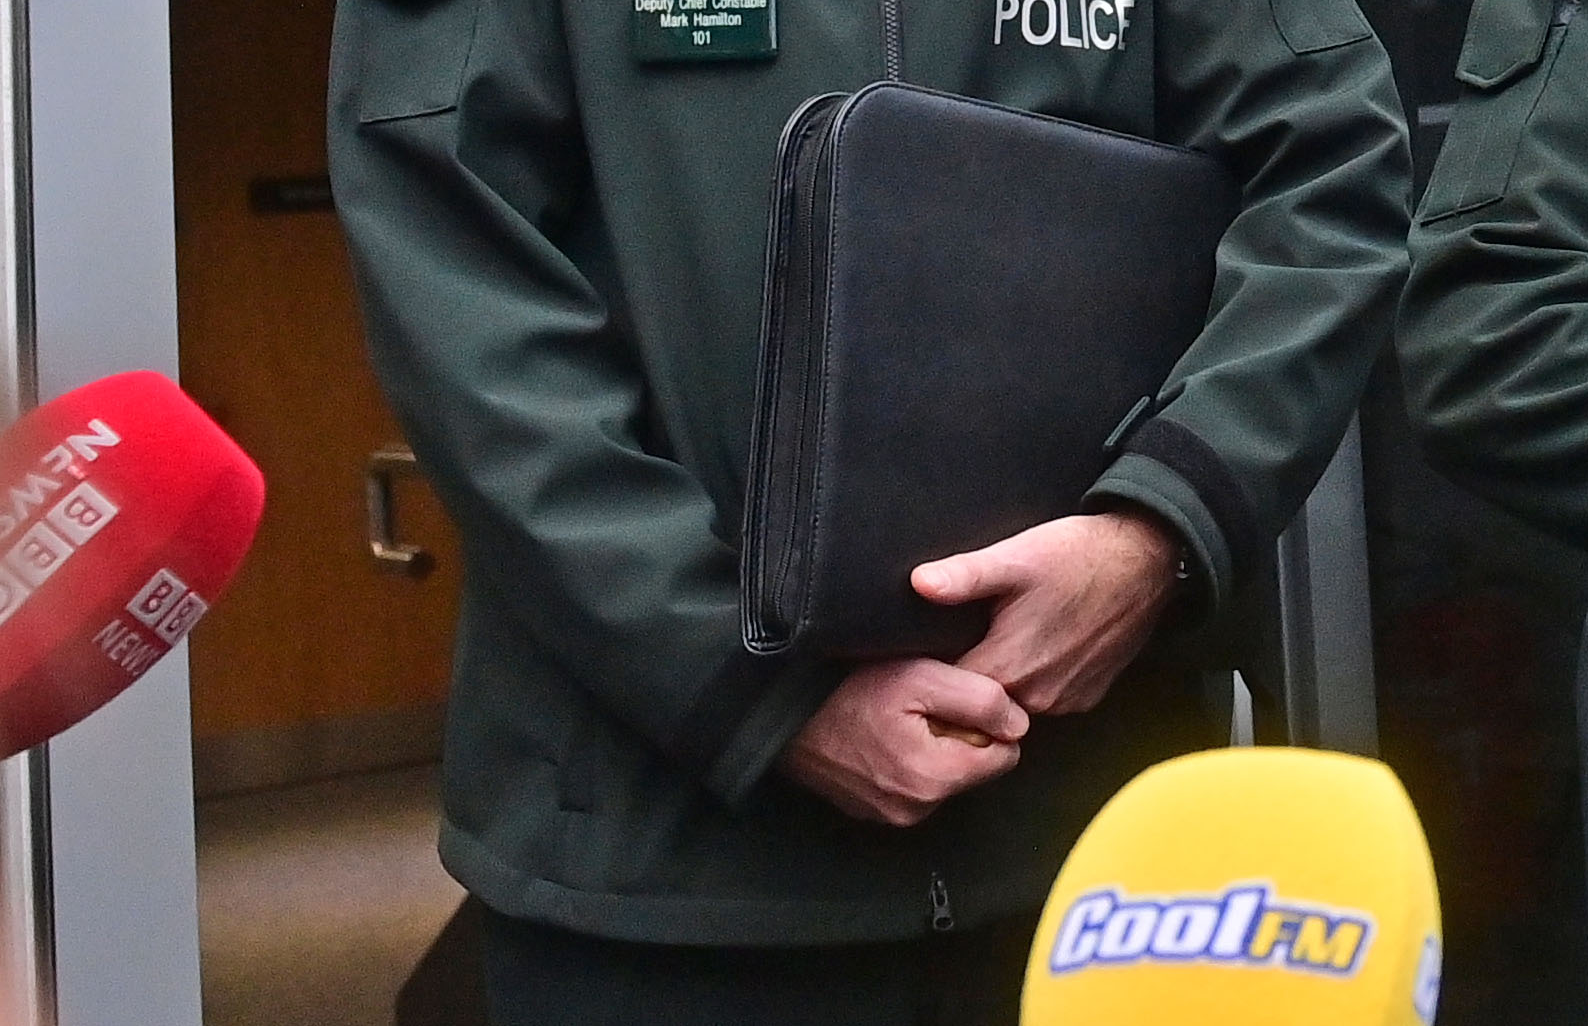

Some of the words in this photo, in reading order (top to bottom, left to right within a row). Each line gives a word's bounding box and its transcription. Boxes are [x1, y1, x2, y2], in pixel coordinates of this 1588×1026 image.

[660, 12, 689, 28] Mark
[693, 11, 742, 27] Hamilton
[691, 30, 711, 45] 101
[91, 618, 162, 677] NEW
